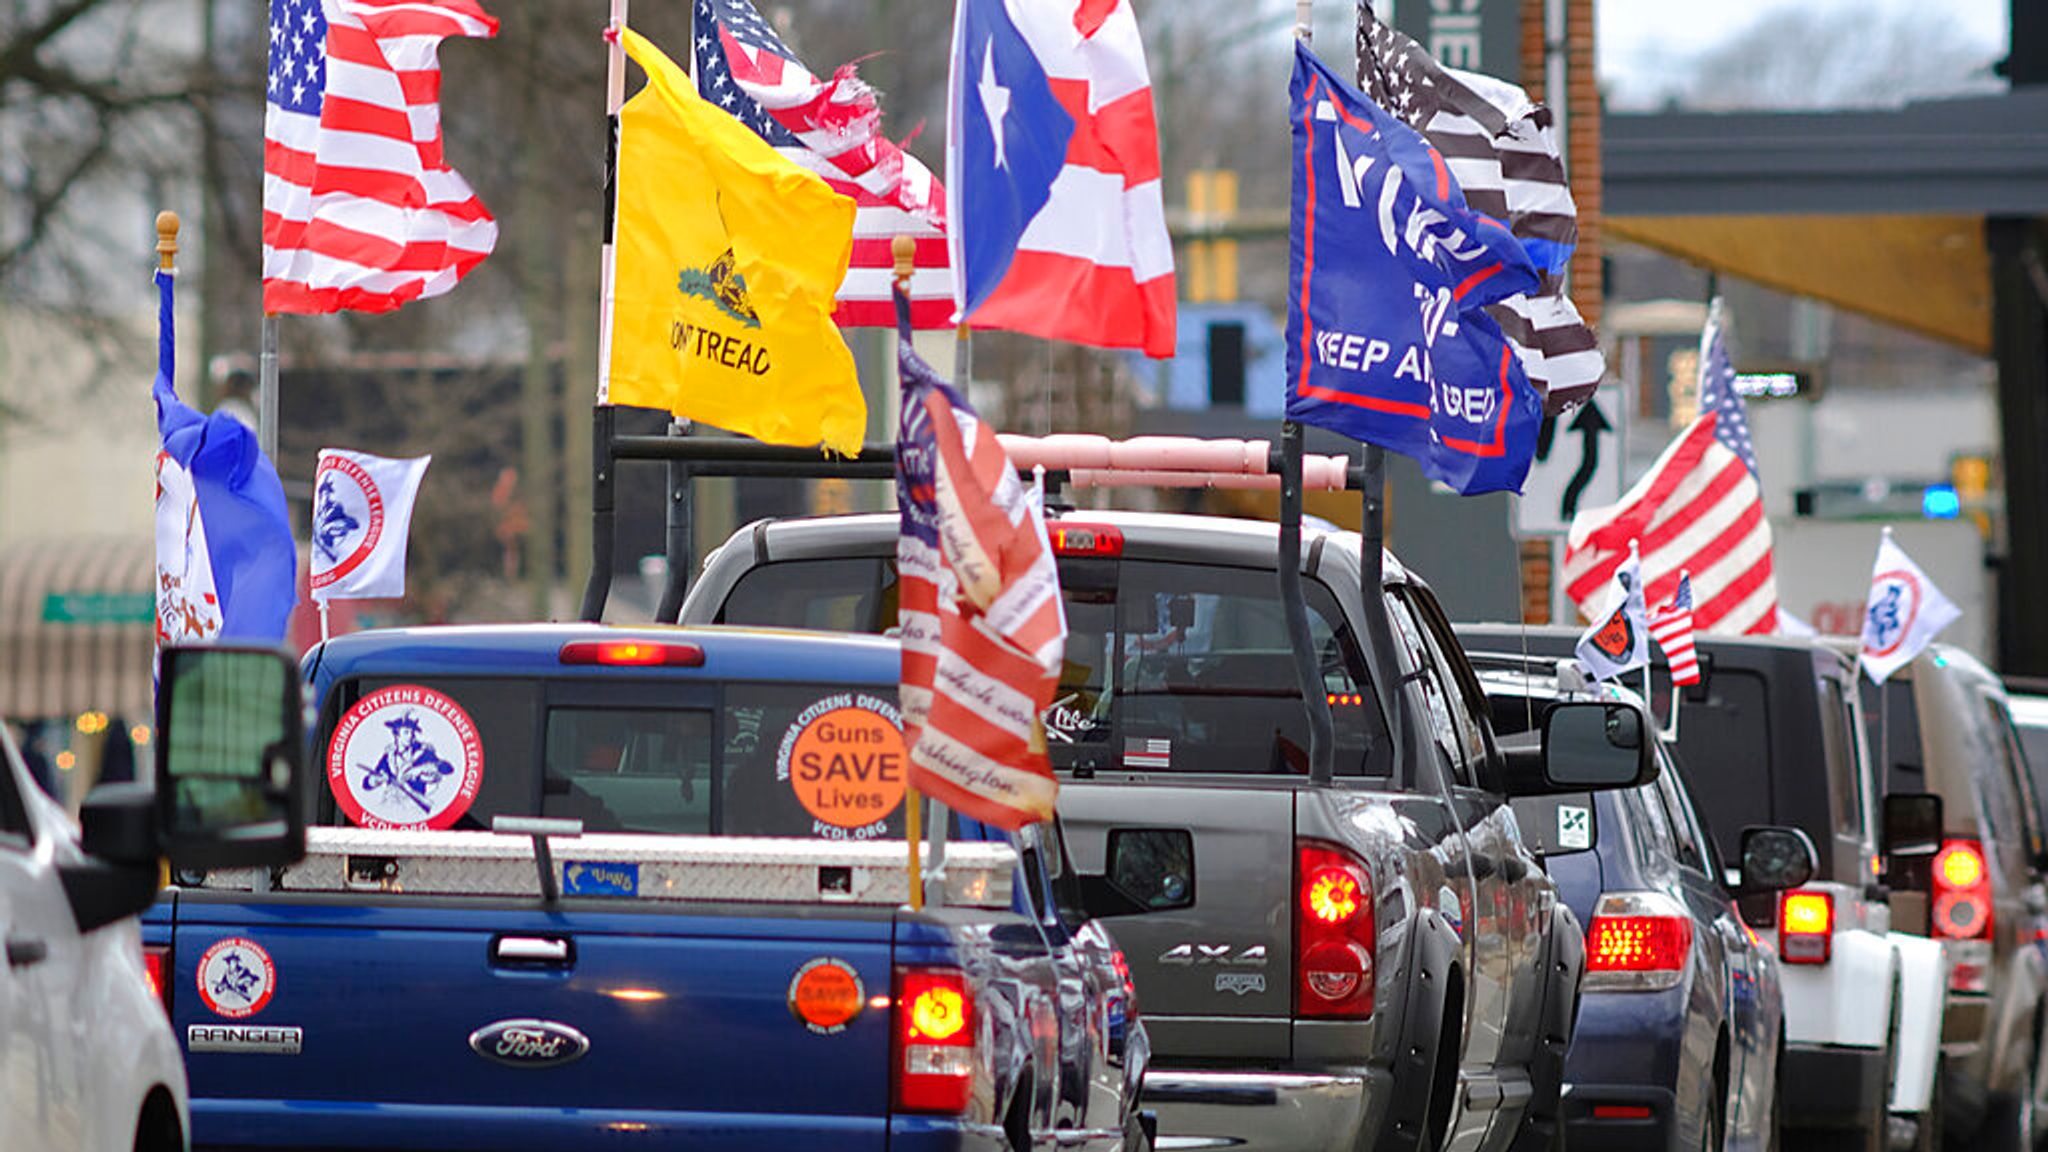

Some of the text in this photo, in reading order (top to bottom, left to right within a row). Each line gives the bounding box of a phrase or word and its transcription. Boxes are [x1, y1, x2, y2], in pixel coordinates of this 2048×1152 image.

[1316, 330, 1390, 373] KEEP
[331, 690, 480, 798] VIRGINIA CITIZENS DEFENSE LEAGUE
[776, 723, 802, 781] VIRGINIA
[797, 693, 852, 727] CITIZENS
[816, 721, 885, 743] Guns
[799, 752, 900, 782] SAVE
[816, 787, 885, 809] Lives
[812, 819, 888, 841] VCDL.ORG
[190, 1028, 300, 1044] RANGER
[495, 1027, 561, 1057] Ford
